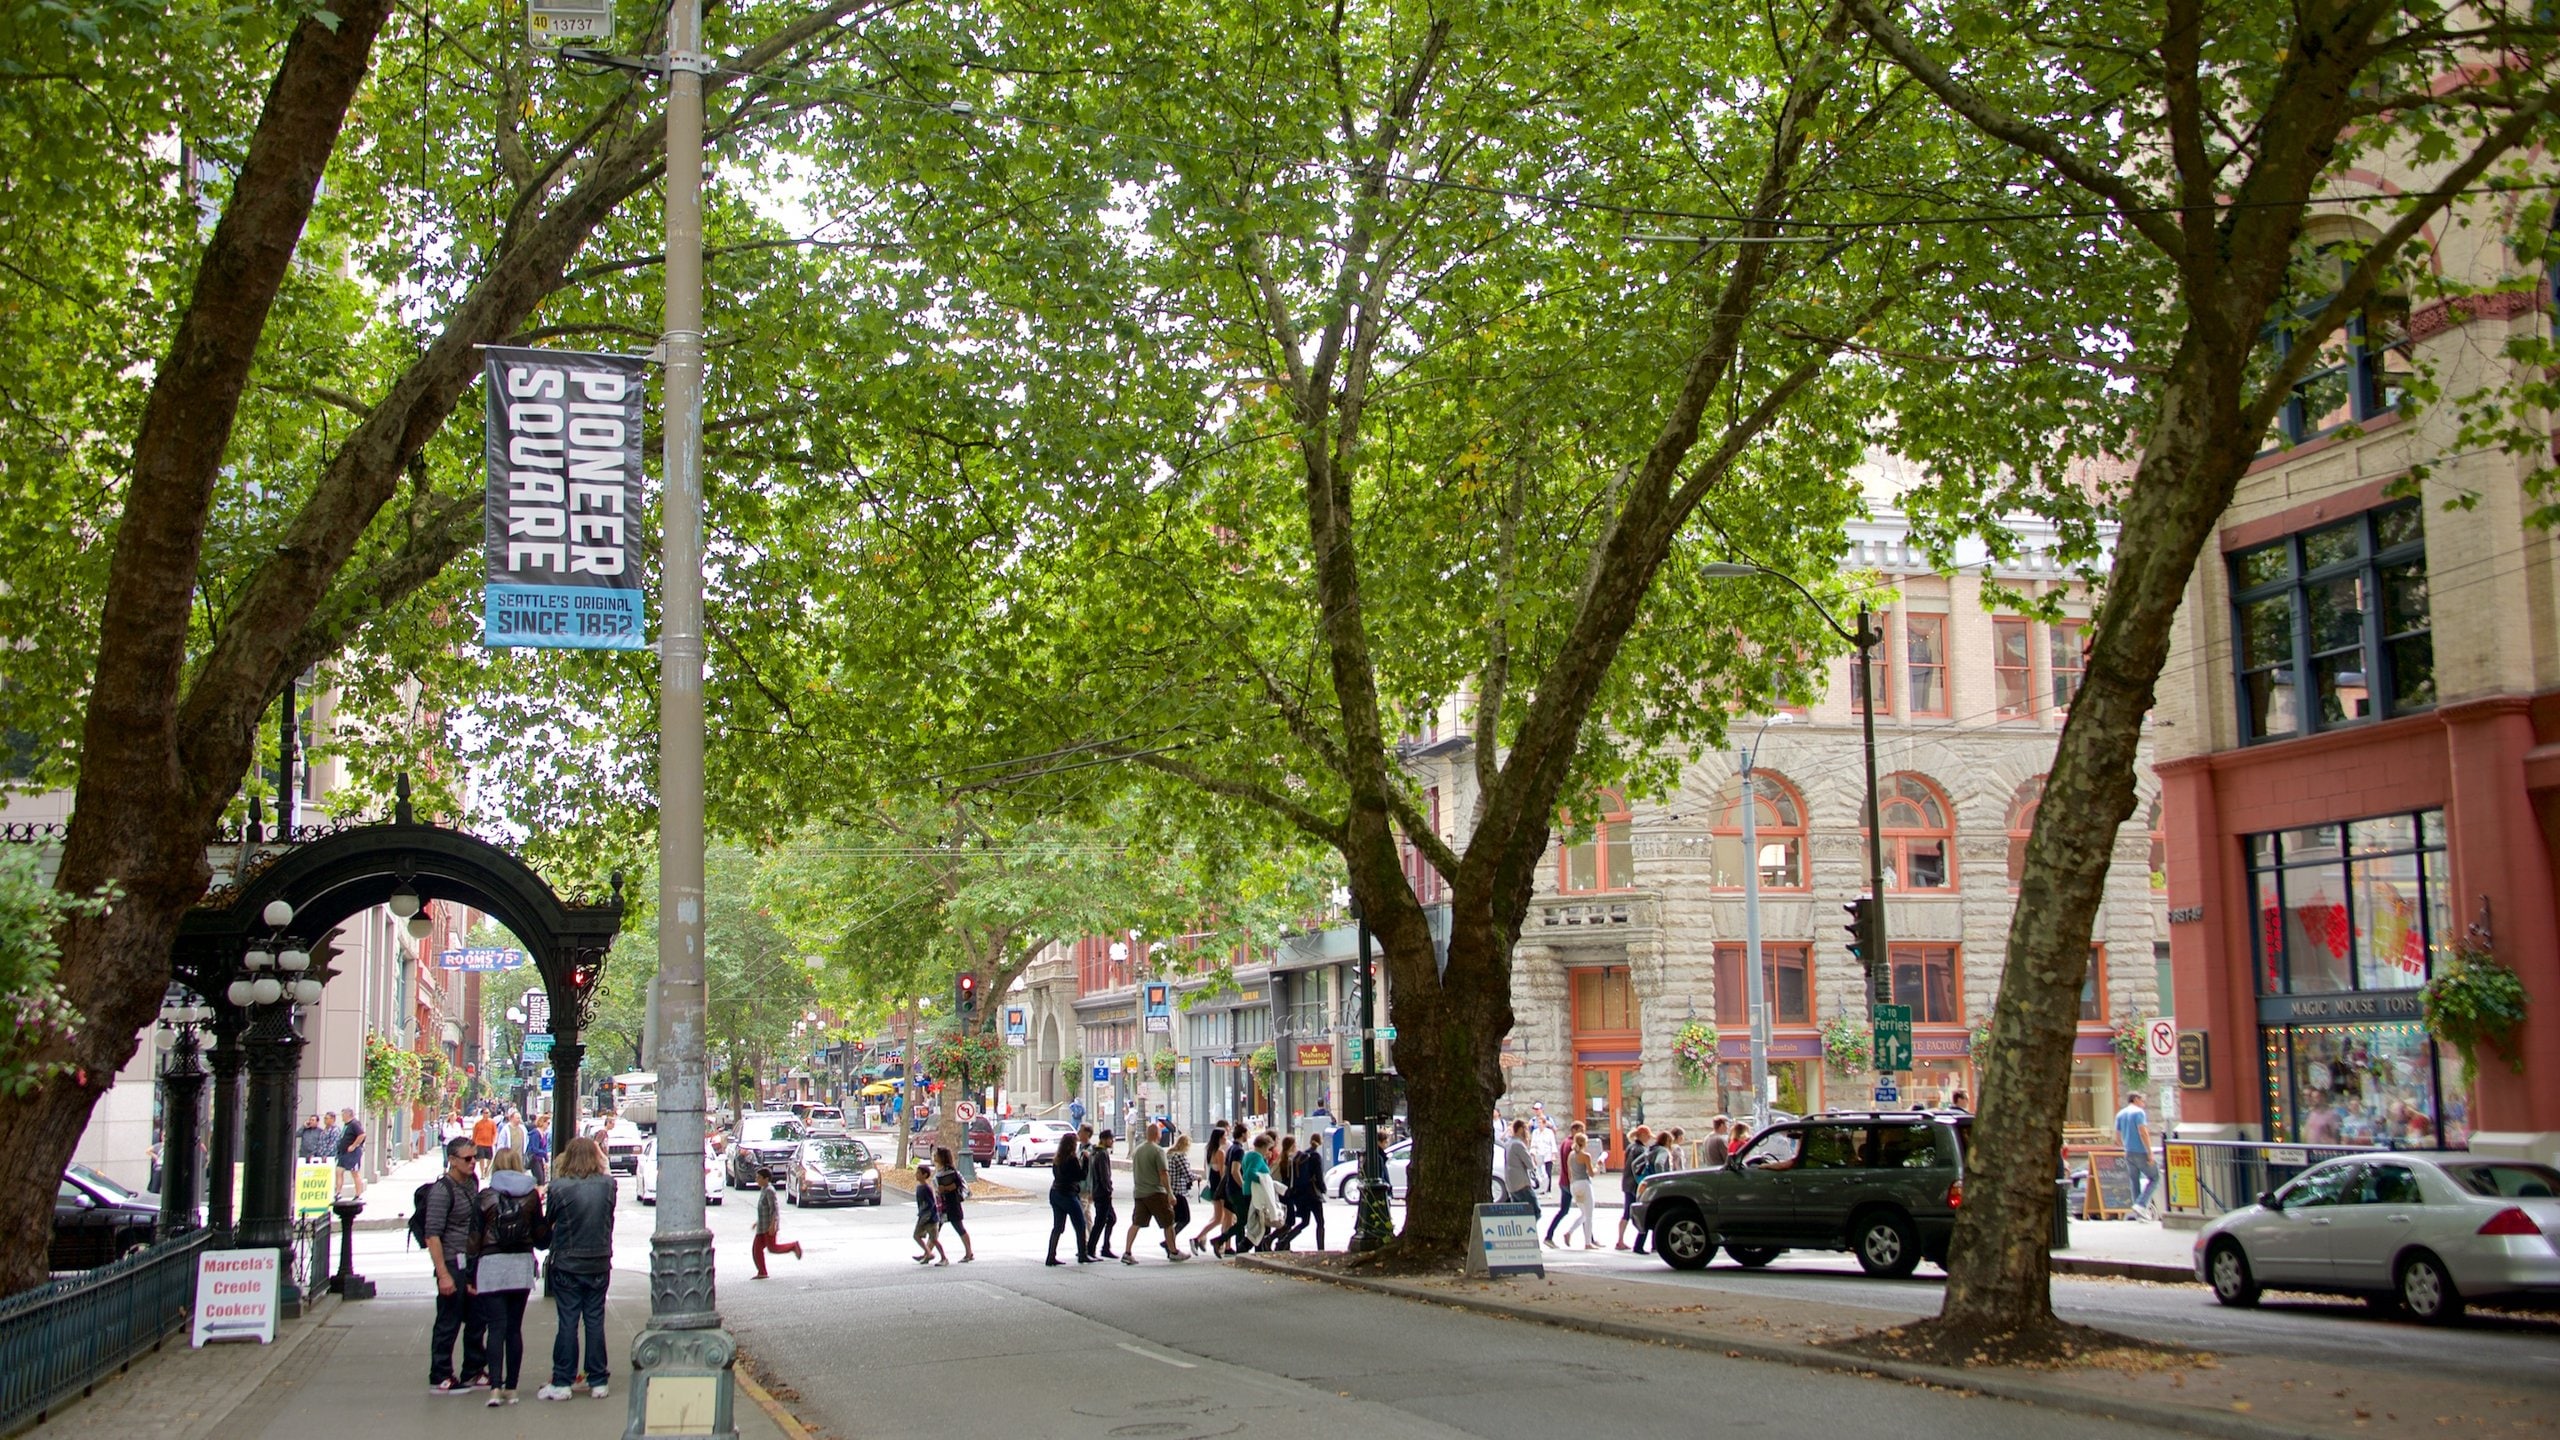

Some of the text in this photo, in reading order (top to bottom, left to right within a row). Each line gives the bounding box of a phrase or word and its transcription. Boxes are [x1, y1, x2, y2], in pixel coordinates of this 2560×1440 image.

[533, 15, 593, 31] 40 13737
[507, 367, 567, 574] SQUARE
[568, 371, 626, 577] PIONEER
[497, 593, 633, 612] SEATTLE'S ORIGINAL
[497, 611, 633, 637] SINCE 1852
[445, 954, 494, 965] ROOMS
[1887, 1008, 1897, 1018] TO
[2291, 996, 2415, 1016] MAGIC MOUSE TOYS
[529, 995, 541, 1034] SQUARE
[1874, 1017, 1910, 1032] Ferries
[526, 1041, 550, 1051] Yesler
[1926, 1039, 1963, 1053] FACTORY
[880, 1056, 904, 1064] HOTE
[1299, 1050, 1330, 1060] Maharaja
[1098, 1068, 1104, 1076] 2
[2170, 1155, 2192, 1168] TOYS
[302, 1180, 327, 1189] NOW
[300, 1191, 328, 1201] OPEN
[1497, 1219, 1523, 1237] nolo
[204, 1256, 274, 1273] Marcela's
[213, 1280, 261, 1295] Creole
[205, 1302, 266, 1318] Cookery
